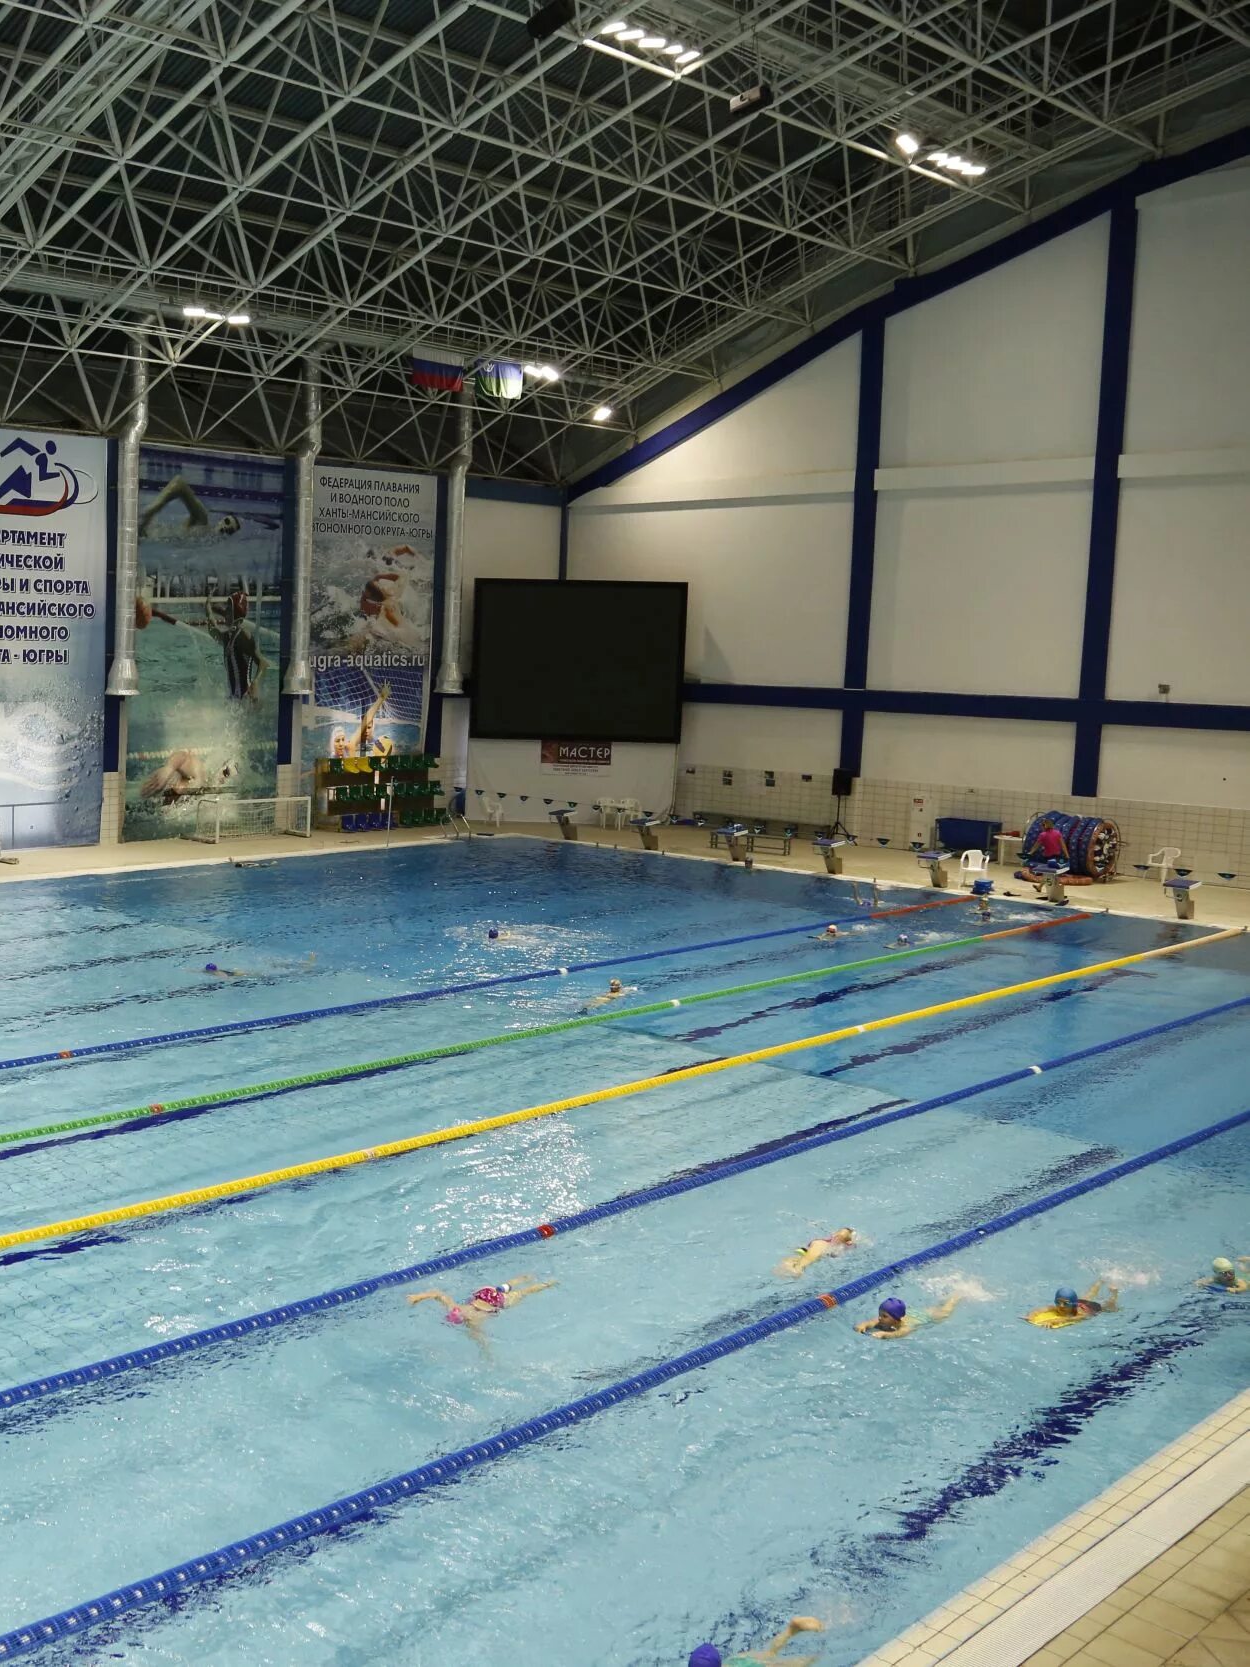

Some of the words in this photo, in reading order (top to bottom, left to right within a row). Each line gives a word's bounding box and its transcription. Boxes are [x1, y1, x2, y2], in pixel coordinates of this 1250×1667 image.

[319, 476, 372, 491] ФЕДЕРАЦИЯ
[374, 481, 420, 494] ПЛАВАНИЯ
[330, 493, 337, 503] И
[339, 493, 382, 506] ВОДНОГО
[384, 497, 410, 508] ПОЛО
[319, 507, 420, 523] ХАНТЫ-МАНСИЙСКОГО
[374, 525, 433, 539] ОКРУГА-ЮГРЫ
[19, 578, 30, 594] И
[33, 578, 91, 595] СПОРТА
[22, 649, 69, 664] ЮГРЫ
[559, 746, 610, 758] МАСТЕР
